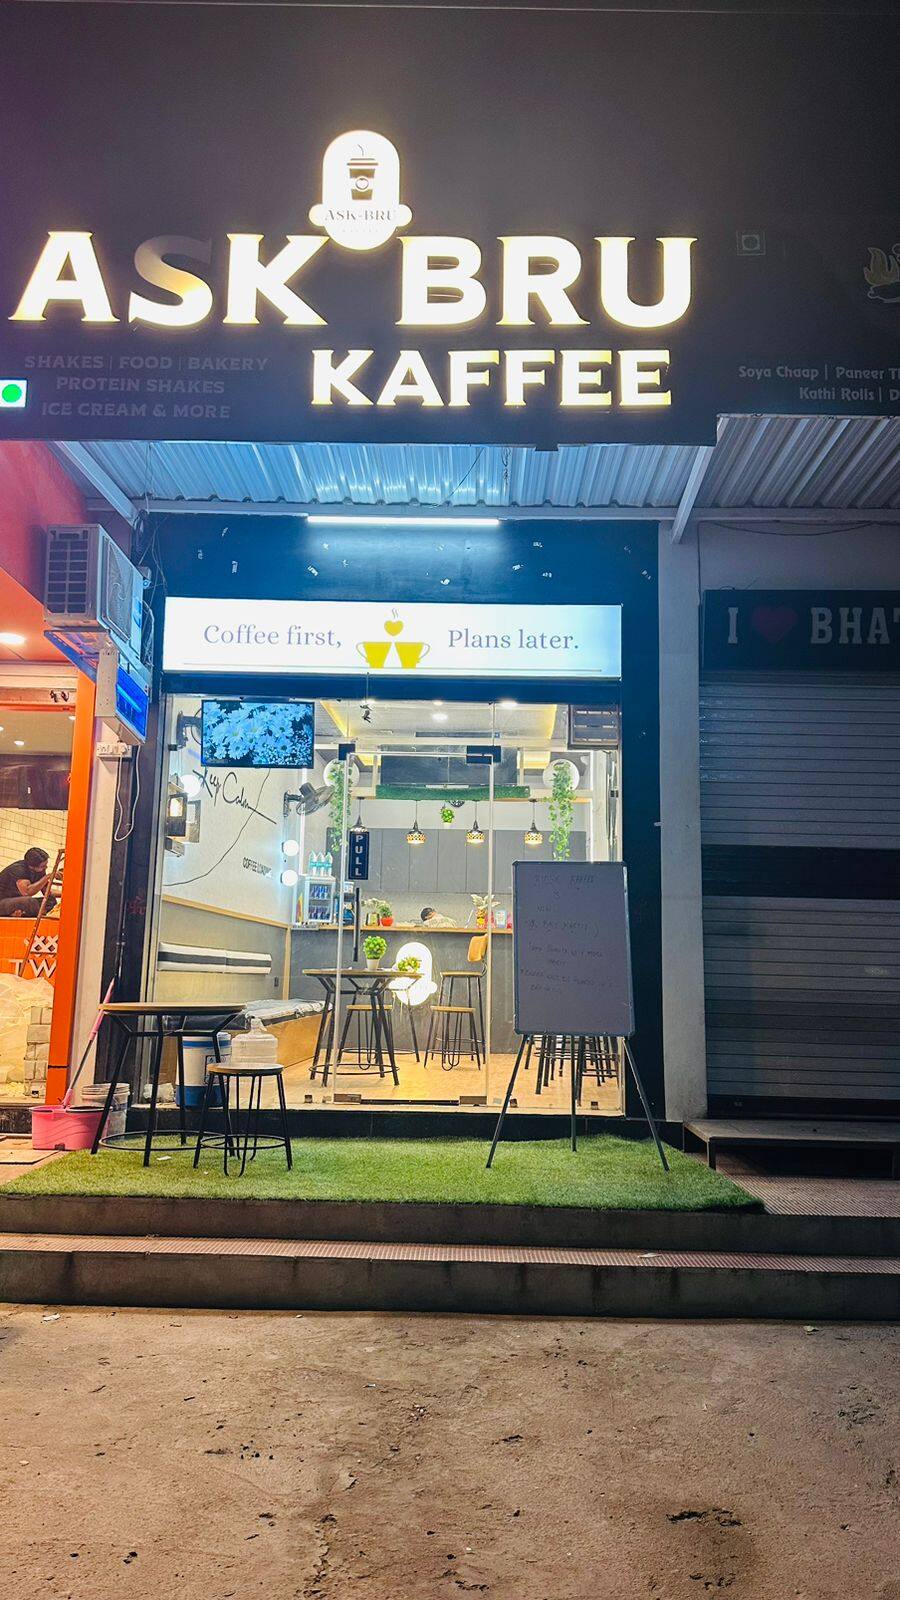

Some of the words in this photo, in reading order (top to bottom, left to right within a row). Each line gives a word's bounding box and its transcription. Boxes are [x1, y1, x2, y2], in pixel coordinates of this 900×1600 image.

[325, 209, 396, 221] ASK-BRU
[8, 231, 331, 327] ASK
[395, 234, 699, 329] BRU
[25, 355, 104, 369] SHAKES
[119, 356, 173, 370] FOOD
[188, 357, 268, 371] BAKERY
[310, 349, 672, 408] KAFFEE
[738, 365, 772, 380] Soya
[776, 366, 819, 381] Chaap
[835, 366, 884, 380] Paneer
[56, 377, 140, 392] PROTEIN
[146, 379, 225, 393] SHAKES
[799, 387, 836, 400] Kathi
[841, 387, 875, 401] Rolls
[42, 402, 72, 416] ICE
[78, 402, 147, 417] CREAM
[152, 403, 166, 418] &
[173, 404, 231, 419] MORE
[727, 607, 739, 644] I
[203, 624, 280, 645] Coffee
[286, 625, 342, 648] first,
[448, 628, 511, 649] Plans
[518, 628, 579, 649] later.
[355, 834, 364, 876] PULL
